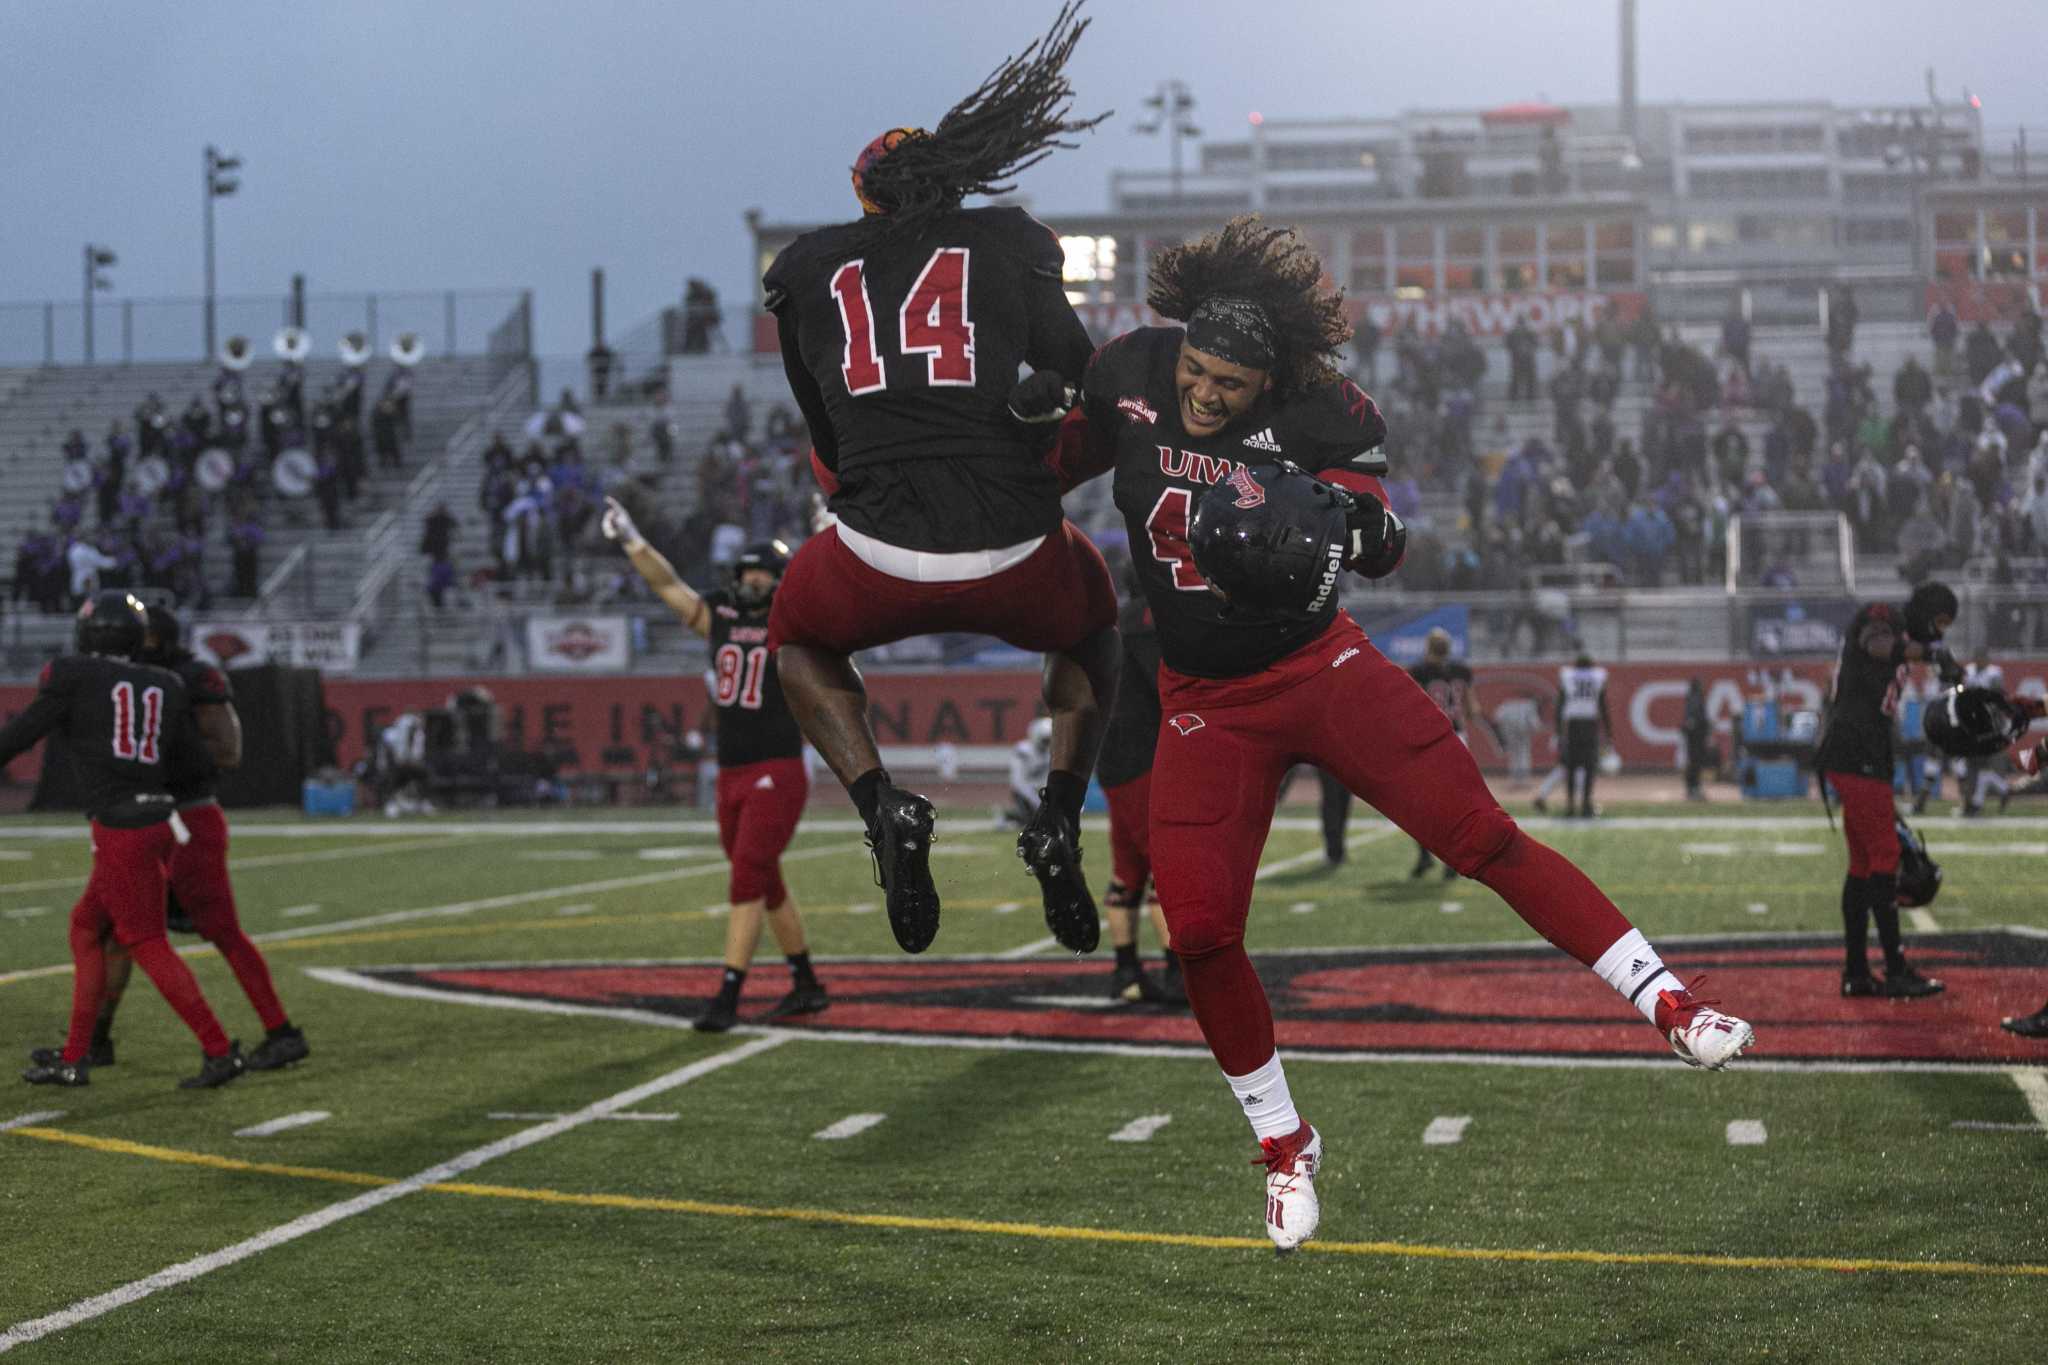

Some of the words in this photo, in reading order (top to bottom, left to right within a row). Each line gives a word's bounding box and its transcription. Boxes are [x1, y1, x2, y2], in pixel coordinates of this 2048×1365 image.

[830, 248, 976, 397] 14
[1155, 444, 1232, 486] UIW
[1242, 438, 1282, 453] adidas
[1306, 543, 1344, 613] Riddell
[716, 644, 768, 709] 81
[111, 681, 164, 764] 11
